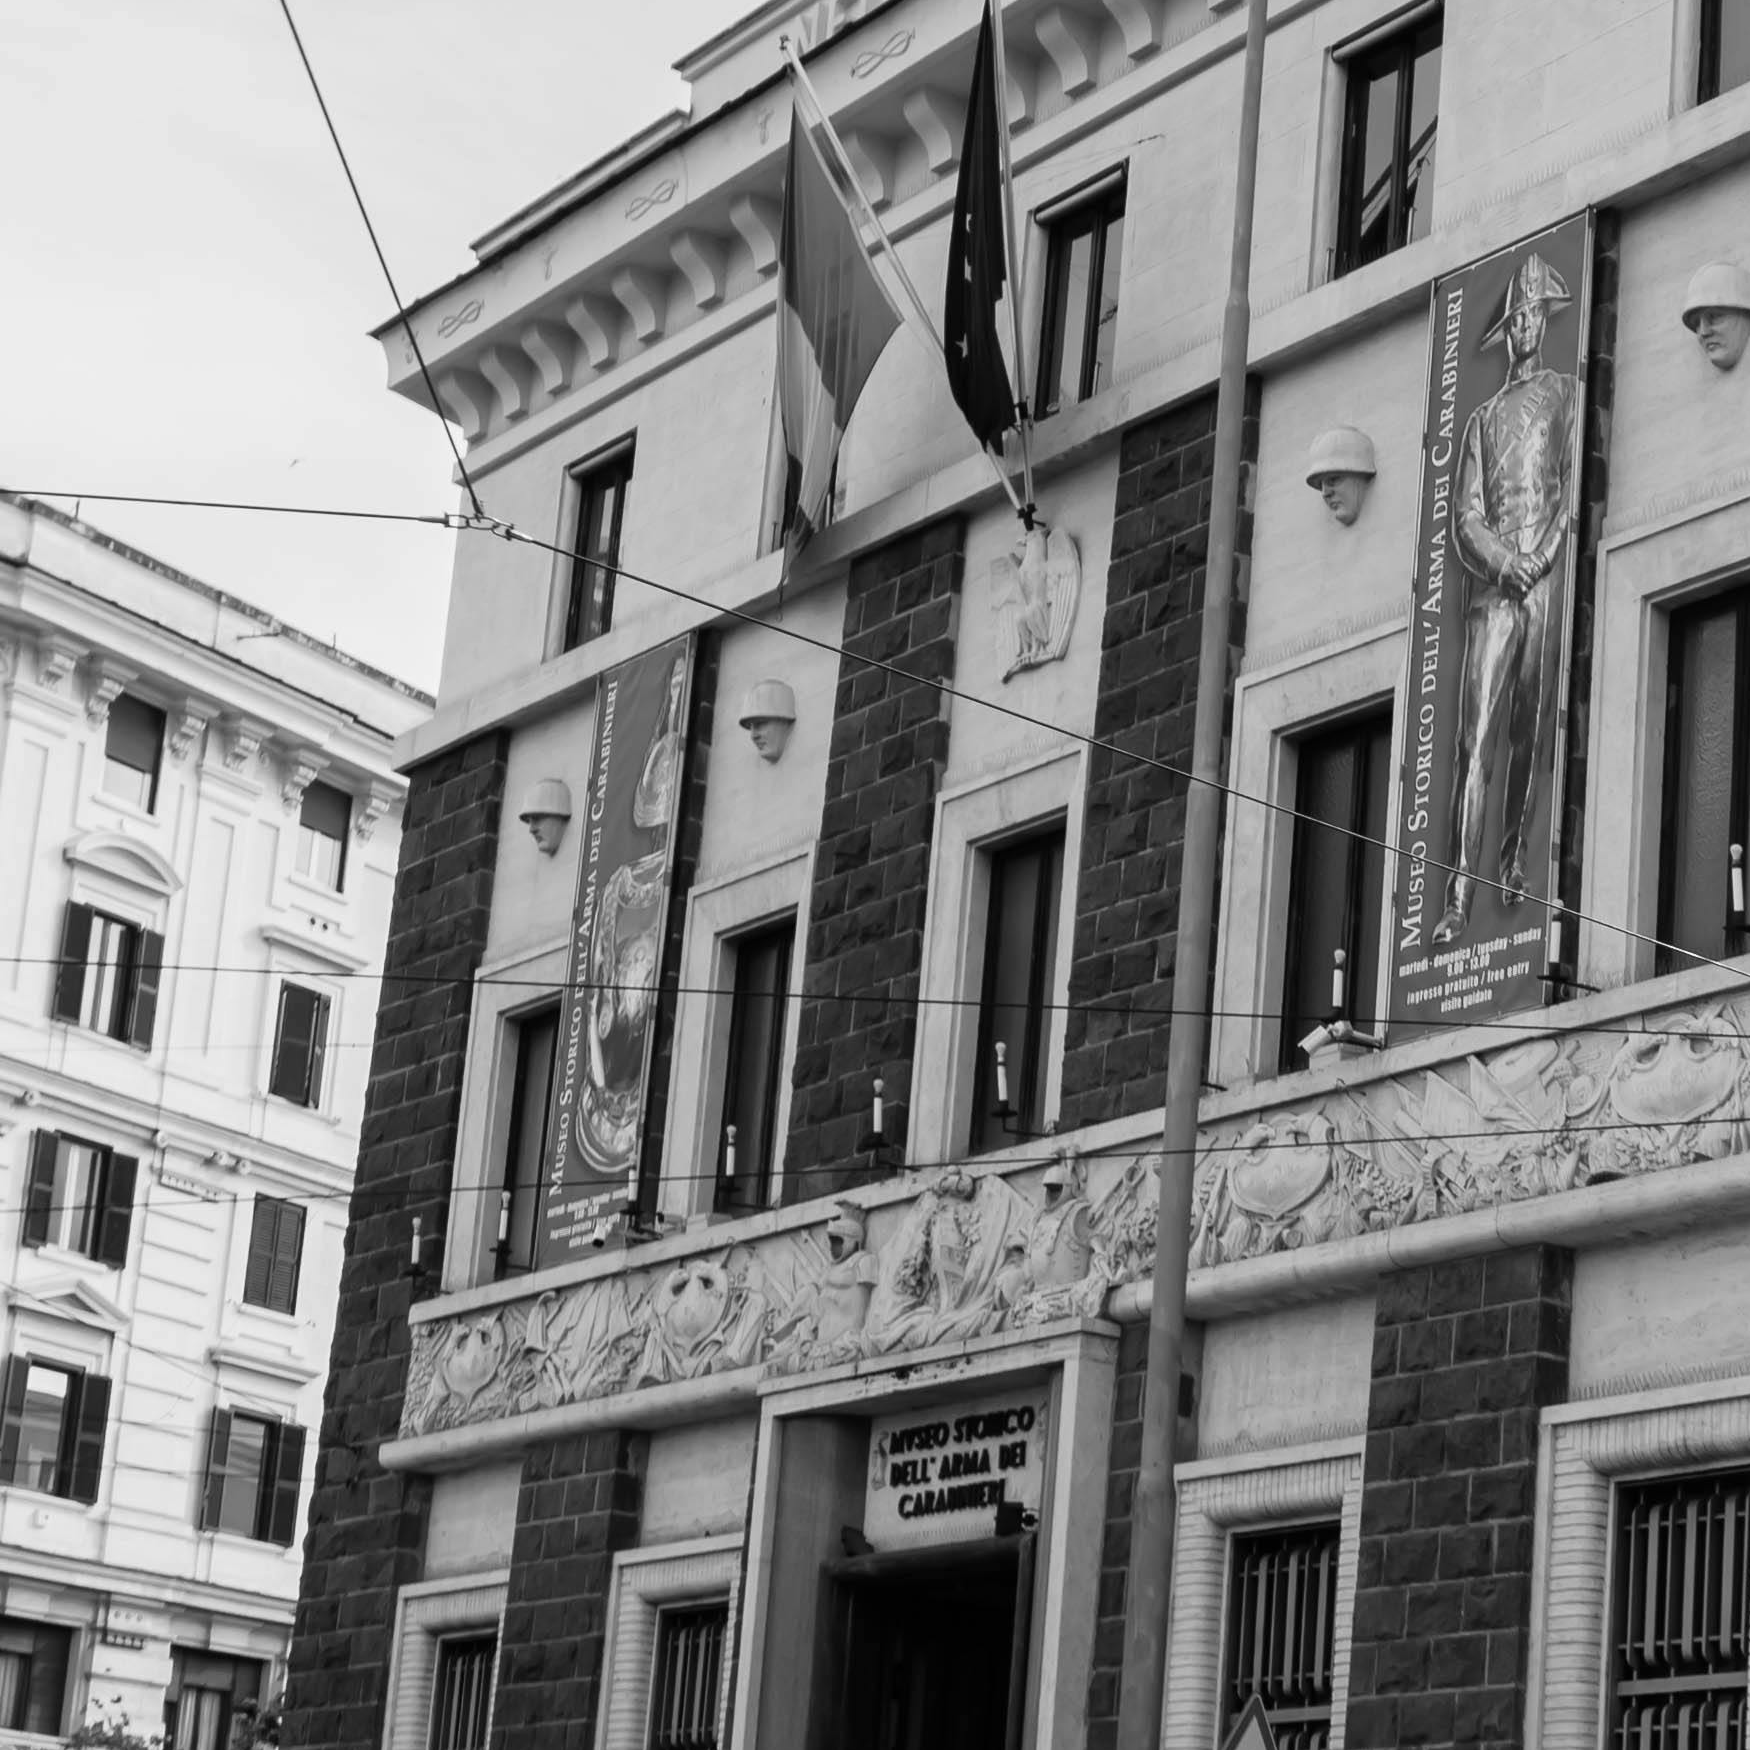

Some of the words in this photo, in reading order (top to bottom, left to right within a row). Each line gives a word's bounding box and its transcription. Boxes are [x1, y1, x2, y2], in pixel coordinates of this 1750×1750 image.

[1431, 287, 1463, 467] CARABINIERI
[1432, 473, 1450, 522] DEI
[591, 680, 618, 822] CARABINIERI
[1407, 704, 1435, 832] STORICO
[589, 826, 602, 864] DEI
[1400, 841, 1427, 951] MUSEO
[1477, 937, 1508, 956] tuesday
[1513, 927, 1542, 946] sunday
[1407, 984, 1443, 1005] ingresso
[559, 1006, 582, 1105] STORICO
[548, 1112, 569, 1197] MUSEO
[953, 1405, 1035, 1443] STORICO
[998, 1440, 1027, 1470] DEI
[897, 1478, 1005, 1519] CARABINIERI
